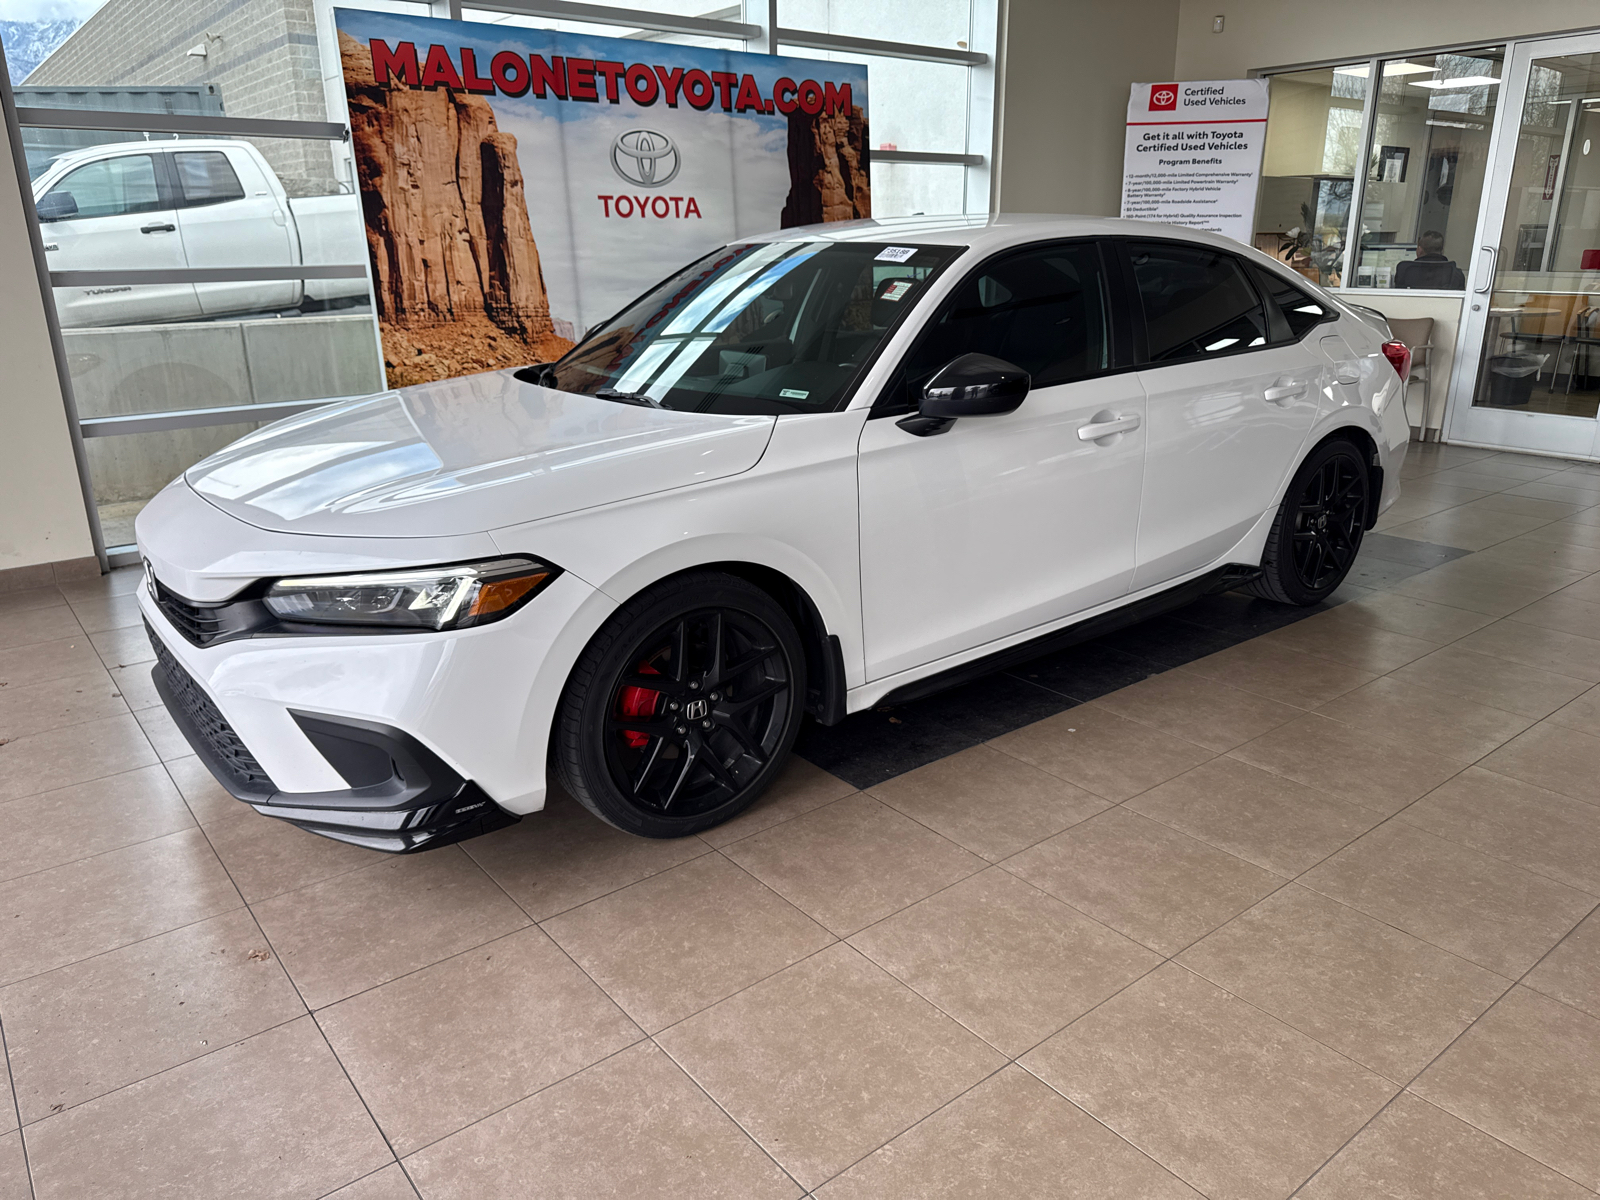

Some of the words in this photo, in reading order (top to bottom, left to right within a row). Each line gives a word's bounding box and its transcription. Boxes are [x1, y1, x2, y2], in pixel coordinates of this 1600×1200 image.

[368, 38, 852, 119] MALONETOYOTA.COM
[1184, 86, 1224, 96] Certified
[1184, 96, 1206, 106] Used
[1208, 96, 1246, 106] Vehicles
[1143, 132, 1161, 141] Get
[1162, 132, 1170, 140] it
[1172, 132, 1184, 140] all
[1186, 132, 1208, 140] with
[1210, 131, 1244, 140] Toyota
[1136, 143, 1179, 152] Certified
[1181, 143, 1205, 151] Used
[1207, 142, 1248, 151] Vehicles
[598, 195, 702, 219] TOYOTA
